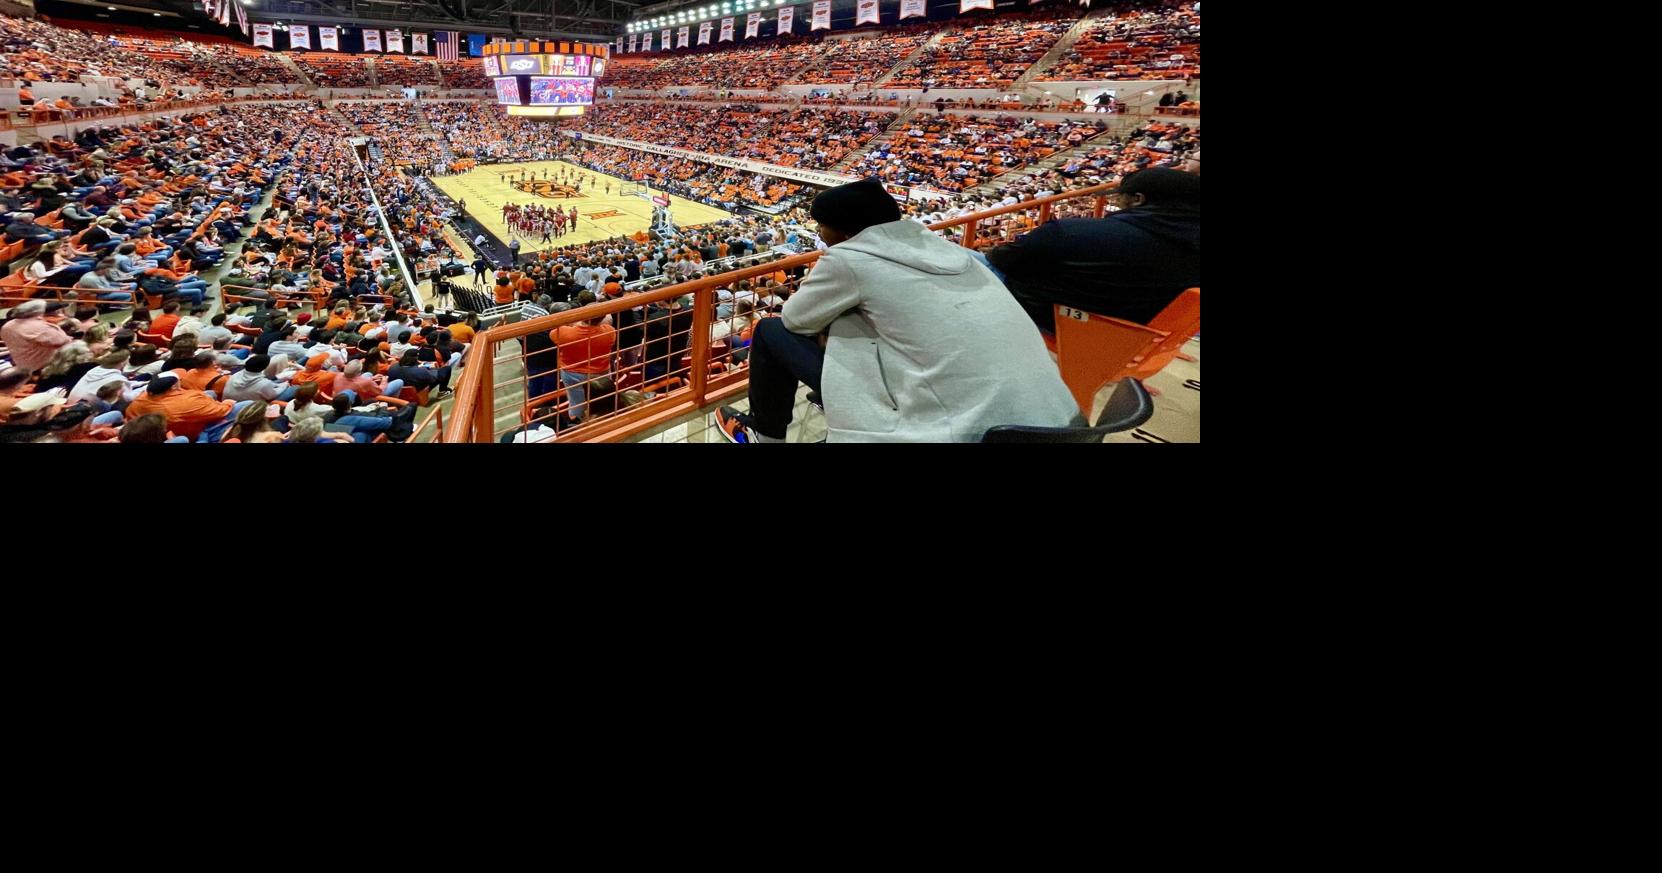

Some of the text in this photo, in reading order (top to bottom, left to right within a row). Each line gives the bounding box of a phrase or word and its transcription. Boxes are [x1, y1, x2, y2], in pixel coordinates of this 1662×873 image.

[616, 141, 643, 149] HISTORIC
[714, 158, 748, 168] ARENA
[762, 166, 820, 181] DEDICATED
[1065, 307, 1083, 320] 13
